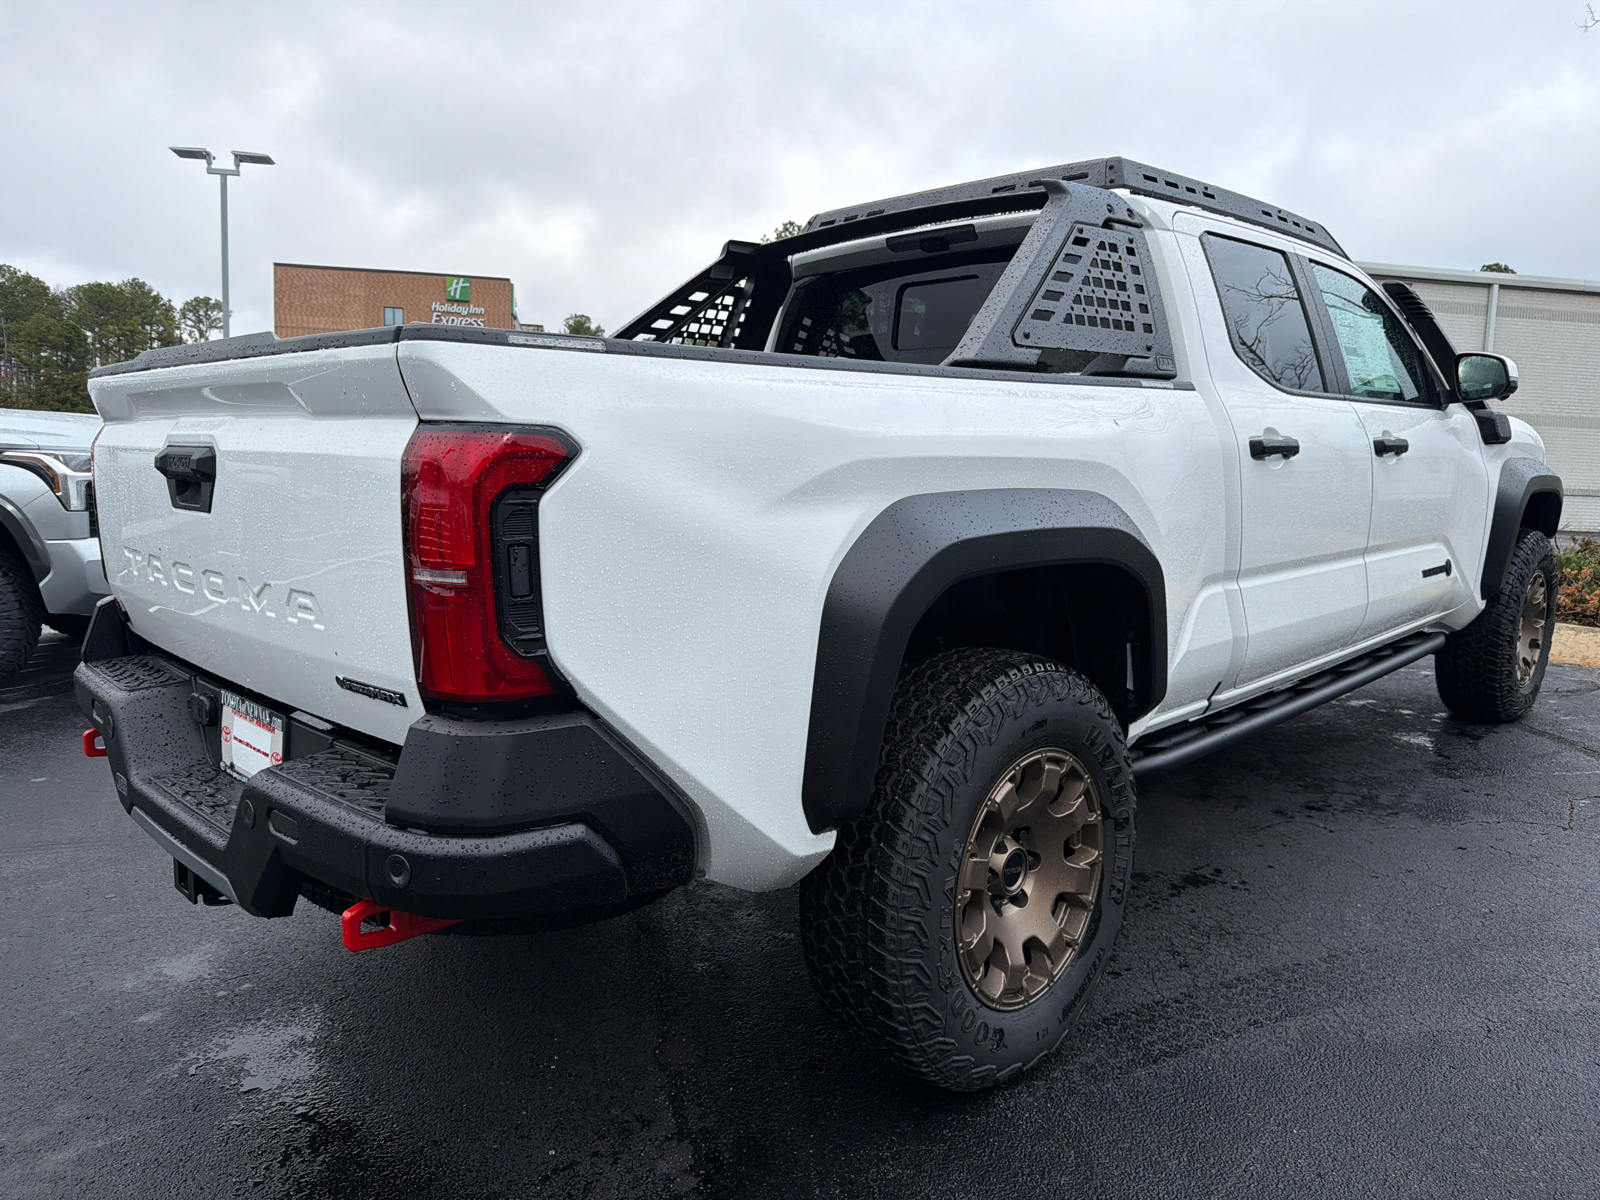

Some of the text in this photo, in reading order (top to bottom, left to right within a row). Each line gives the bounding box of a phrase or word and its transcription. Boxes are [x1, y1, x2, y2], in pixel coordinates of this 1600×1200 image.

[431, 302, 485, 315] Holiday Inn
[431, 312, 485, 327] Express
[123, 545, 325, 631] TACOMA
[1082, 725, 1130, 905] WRANGLER
[1003, 866, 1022, 876] TOYOTA
